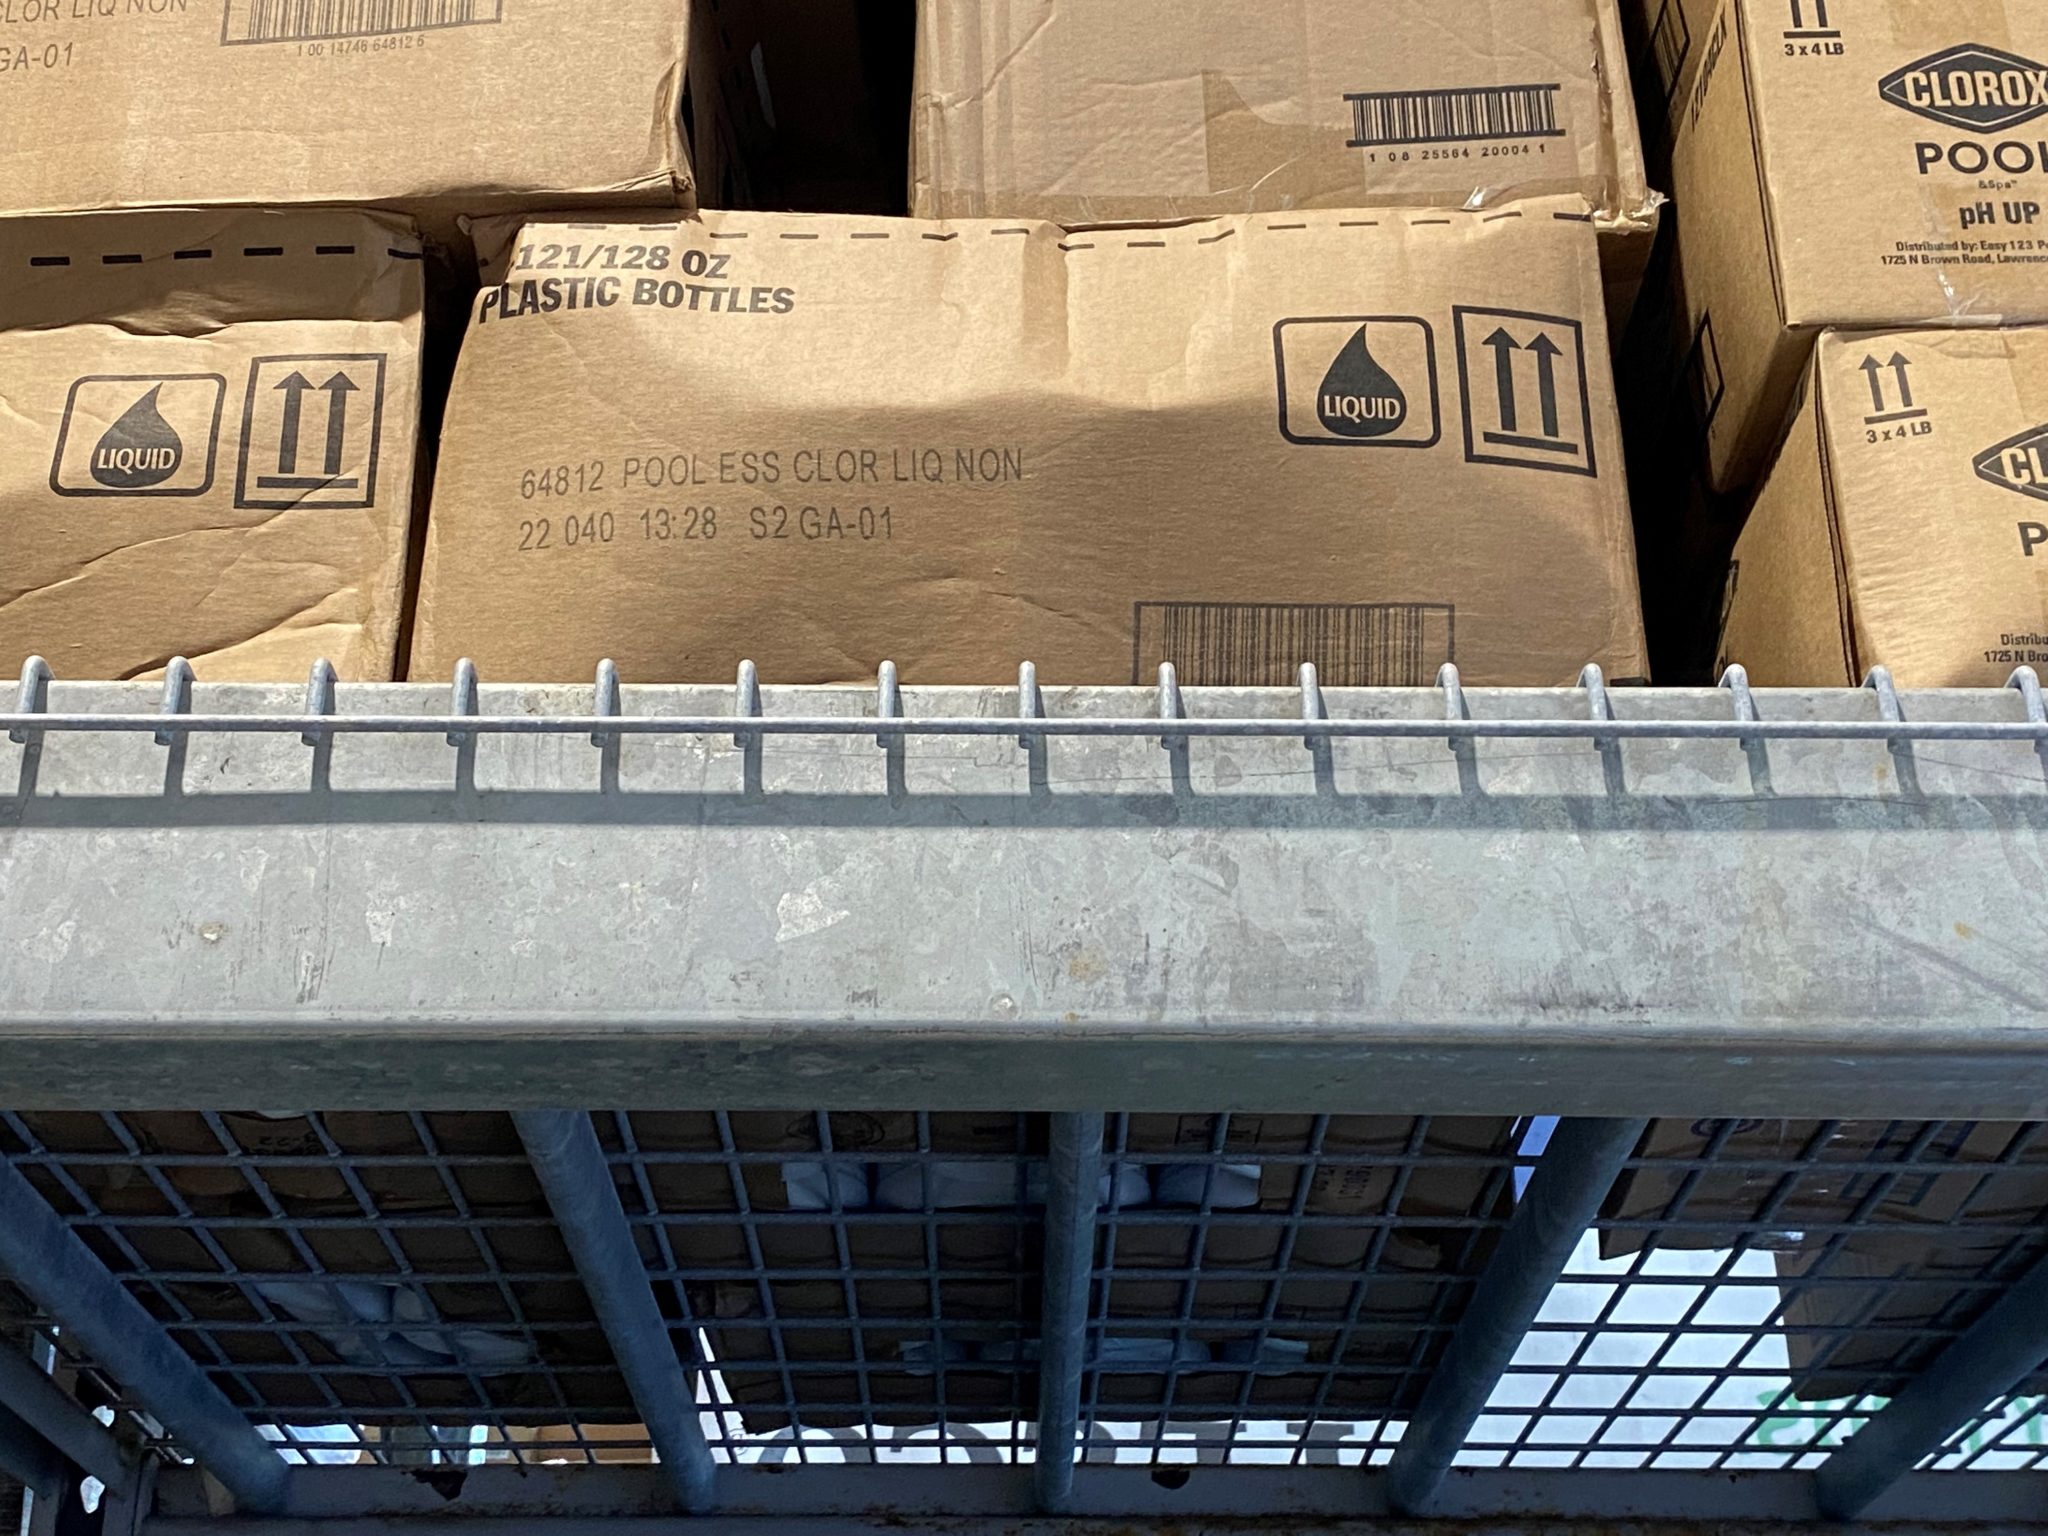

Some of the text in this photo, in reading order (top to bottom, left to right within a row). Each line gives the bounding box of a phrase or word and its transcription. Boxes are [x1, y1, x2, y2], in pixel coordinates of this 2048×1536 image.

[0, 0, 60, 23] LOR
[308, 43, 324, 56] 00
[331, 39, 368, 56] 14746
[373, 36, 413, 52] 64812
[1785, 42, 1844, 56] 3 x 4 LB
[1903, 70, 2048, 107] CLOROX
[1369, 153, 1376, 162] 1
[1421, 148, 1470, 161] 25564
[1481, 144, 1529, 157] 20004
[1539, 144, 1546, 154] 1
[1959, 201, 2040, 230] pH UP
[1896, 241, 1959, 252] Distributed
[1961, 241, 1978, 253] by:
[1980, 240, 2007, 253] Easy
[1881, 255, 1907, 265] 1725
[1909, 254, 1919, 264] N
[1921, 254, 1960, 265] Brown
[1996, 253, 2048, 264] Lawrenc
[479, 276, 796, 324] PLASTIC BOTTLES
[1323, 395, 1401, 423] LIQUID
[1866, 421, 1932, 443] 3 x 4 LB
[96, 447, 176, 475] LIQUID
[520, 447, 1022, 500] 64812 POOL ESS CLOR LIQ NON
[517, 505, 893, 551] 22 040 13:28 S2 GA-01
[1983, 650, 2012, 663] 1725
[2014, 650, 2024, 662] N
